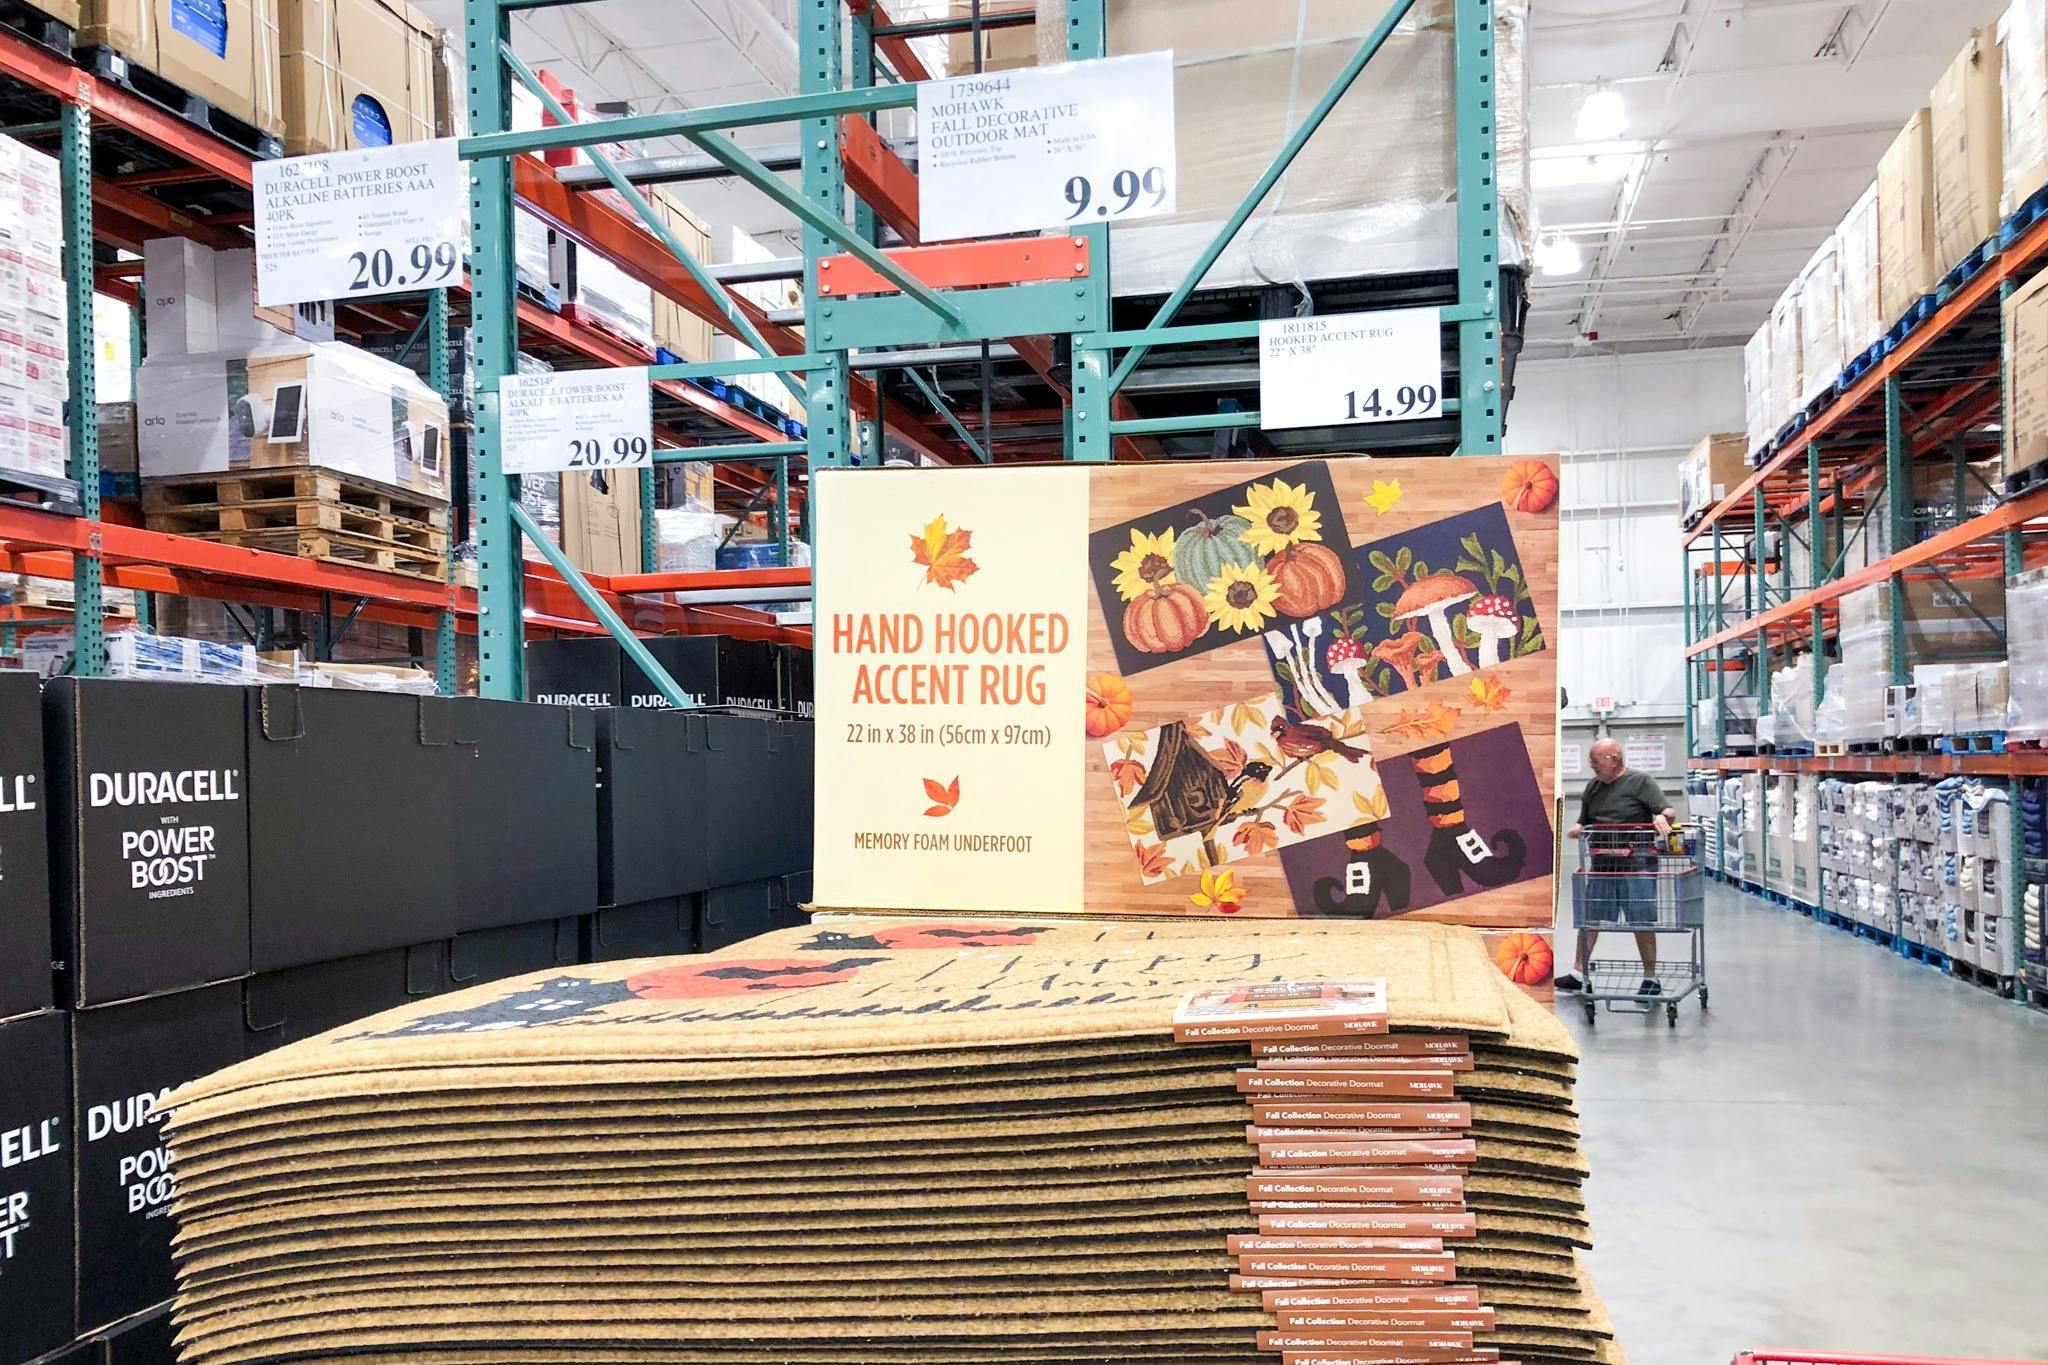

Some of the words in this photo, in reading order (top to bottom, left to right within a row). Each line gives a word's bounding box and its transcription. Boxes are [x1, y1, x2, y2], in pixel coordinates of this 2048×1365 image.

[950, 78, 1011, 99] 1739644
[931, 97, 1005, 118] MOHAWK
[931, 118, 975, 135] FALL
[976, 103, 1079, 129] DECORATIVE
[931, 127, 1009, 150] OUTDOOR
[1013, 122, 1049, 139] MAT
[265, 176, 333, 195] DURACELL
[337, 170, 382, 185] POWER
[386, 163, 428, 180] BOOST
[266, 191, 329, 209] ALKALINE
[333, 182, 403, 201] BATTERIES
[406, 178, 435, 192] AAA
[1064, 166, 1168, 221] 9.99
[266, 209, 296, 223] 40PK
[348, 241, 457, 290] 20.99
[1283, 320, 1327, 334] 1811815
[1269, 334, 1317, 346] HOOKED
[1320, 330, 1366, 342] ACCENT
[1369, 328, 1393, 339] RUG
[1289, 346, 1297, 356] X
[596, 382, 626, 392] BOOST
[1344, 385, 1437, 419] 14.99
[568, 436, 647, 466] 20.99
[833, 613, 924, 654] HAND
[935, 612, 1070, 655] HOOKED
[852, 663, 970, 705] ACCENT
[980, 664, 1047, 706] RUG
[631, 694, 706, 707] DURALL
[846, 724, 863, 743] 22
[867, 723, 881, 743] in
[886, 730, 894, 743] x
[898, 724, 916, 744] 38
[920, 724, 934, 744] in
[939, 724, 986, 747] (56cm
[991, 731, 999, 744] x
[1004, 725, 1051, 748] 97cm)
[90, 769, 239, 807] DURACELL
[160, 816, 179, 825] WITH
[122, 825, 215, 860] POWER
[854, 832, 910, 850] MEMORY
[914, 833, 949, 851] FOAM
[954, 834, 1033, 853] UNDERFOOT
[149, 887, 194, 900] INGREDIENTS
[1185, 1028, 1198, 1036] Fall
[1200, 1026, 1240, 1035] Collection
[1242, 1025, 1283, 1034] Decorative
[1284, 1023, 1319, 1032] Doormat
[1344, 1021, 1378, 1029] MOHAWK
[1263, 1045, 1276, 1054] Fall
[1277, 1044, 1319, 1053] Collection
[1321, 1043, 1362, 1051] Decorative
[1364, 1042, 1399, 1050] Doormat
[1248, 1078, 1262, 1086] Fall
[1263, 1078, 1305, 1087] Collection
[1306, 1079, 1347, 1088] Decorative
[1349, 1080, 1384, 1088] Doormat
[1265, 1111, 1279, 1120] Fall
[1280, 1111, 1322, 1120] Collection
[1323, 1111, 1365, 1120] Decorative
[1366, 1111, 1401, 1120] Doormat
[1258, 1129, 1272, 1137] Fall
[1273, 1128, 1314, 1136] Collection
[1271, 1150, 1285, 1158] Fall
[1286, 1149, 1328, 1158] Collection
[1329, 1149, 1371, 1157] Decorative
[1372, 1148, 1407, 1156] Doormat
[120, 1147, 177, 1186] POW
[129, 1172, 177, 1213] BOO
[1258, 1184, 1272, 1193] Fall
[1273, 1184, 1314, 1193] Collection
[1316, 1185, 1358, 1193] Decorative
[1359, 1185, 1393, 1193] Doormat
[1270, 1221, 1285, 1229] Fall
[1286, 1221, 1327, 1229] Collection
[1329, 1221, 1370, 1229] Decorative
[1372, 1221, 1406, 1229] Doormat
[1239, 1241, 1253, 1249] Fall
[1254, 1240, 1295, 1249] Collection
[1297, 1241, 1338, 1249] Decorative
[1251, 1262, 1265, 1270] Fall
[1266, 1262, 1307, 1271] Collection
[1308, 1263, 1350, 1271] Decorative
[1351, 1263, 1386, 1272] Doormat
[1411, 1265, 1445, 1273] MOHAWK
[1241, 1280, 1255, 1288] Fall
[1256, 1280, 1297, 1288] Collection
[1274, 1298, 1288, 1306] Fall
[1290, 1297, 1331, 1306] Collection
[1332, 1296, 1374, 1305] Decorative
[1375, 1295, 1409, 1304] Doormat
[1434, 1295, 1468, 1303] MOHAWK
[1289, 1317, 1304, 1325] Fall
[1305, 1317, 1346, 1325] Collection
[1347, 1318, 1389, 1326] Decorative
[1390, 1318, 1425, 1327] Doormat
[1450, 1319, 1484, 1327] MOHAWK
[1268, 1338, 1283, 1346] Fall
[1284, 1338, 1325, 1346] Collection
[1326, 1338, 1368, 1346] Decorative
[1369, 1338, 1403, 1347] Doormat
[1428, 1340, 1463, 1348] MOHAWK
